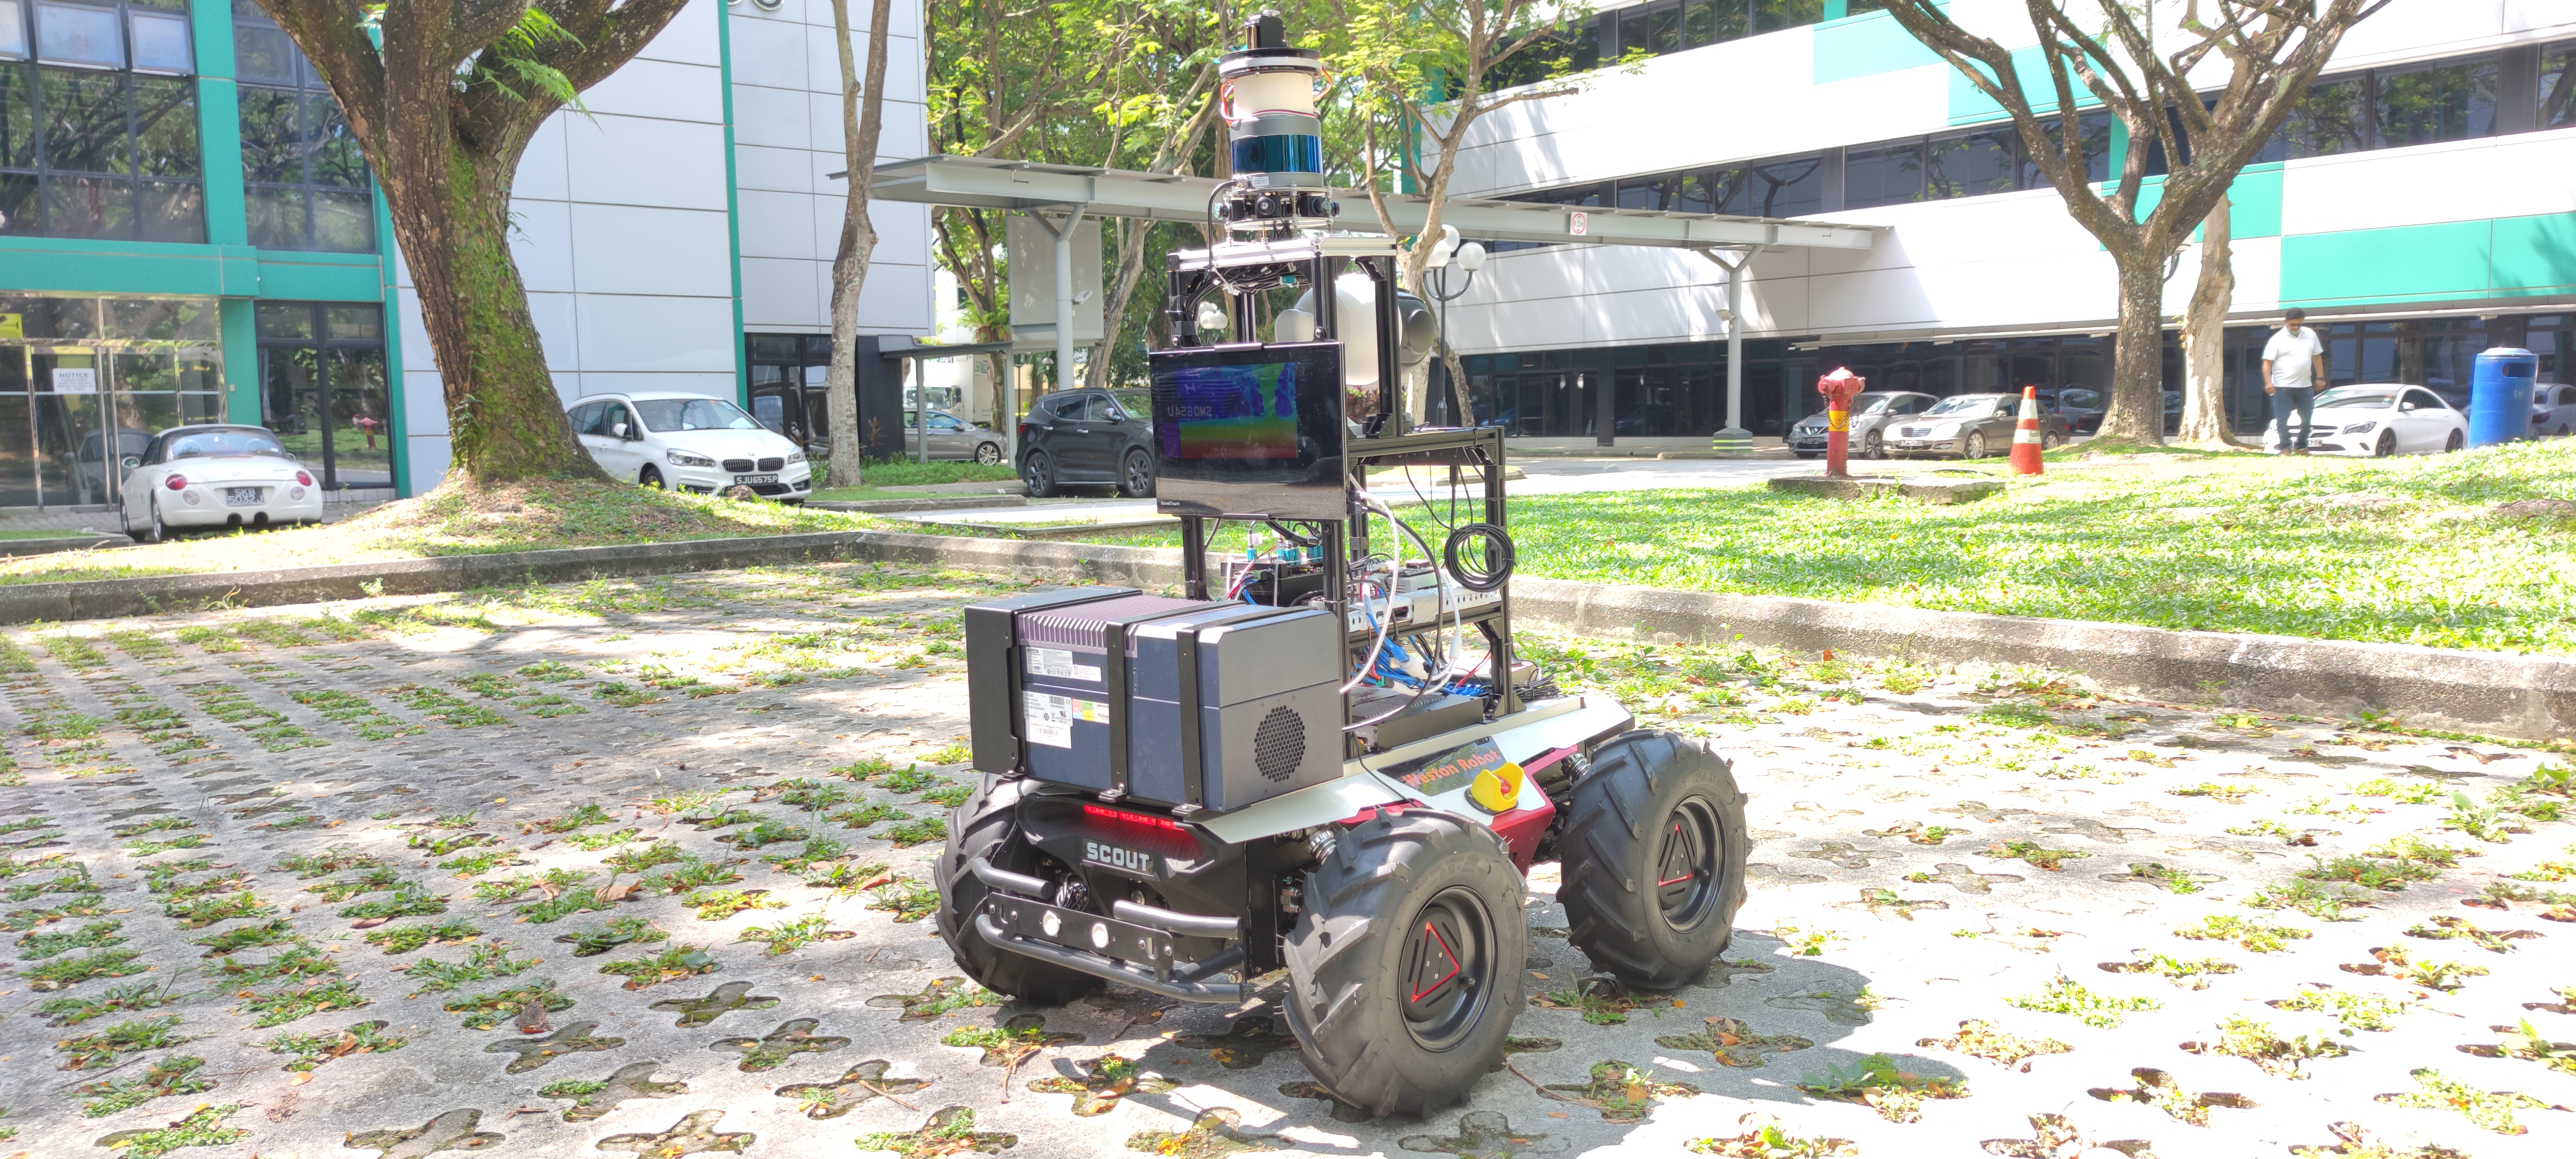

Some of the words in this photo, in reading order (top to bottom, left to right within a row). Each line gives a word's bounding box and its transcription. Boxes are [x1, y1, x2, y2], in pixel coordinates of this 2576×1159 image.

[737, 475, 778, 484] SJU6575P
[228, 495, 263, 503] 5032J
[1402, 764, 1459, 787] Weston
[1456, 750, 1501, 771] Robot
[1087, 842, 1149, 871] SCOUT
